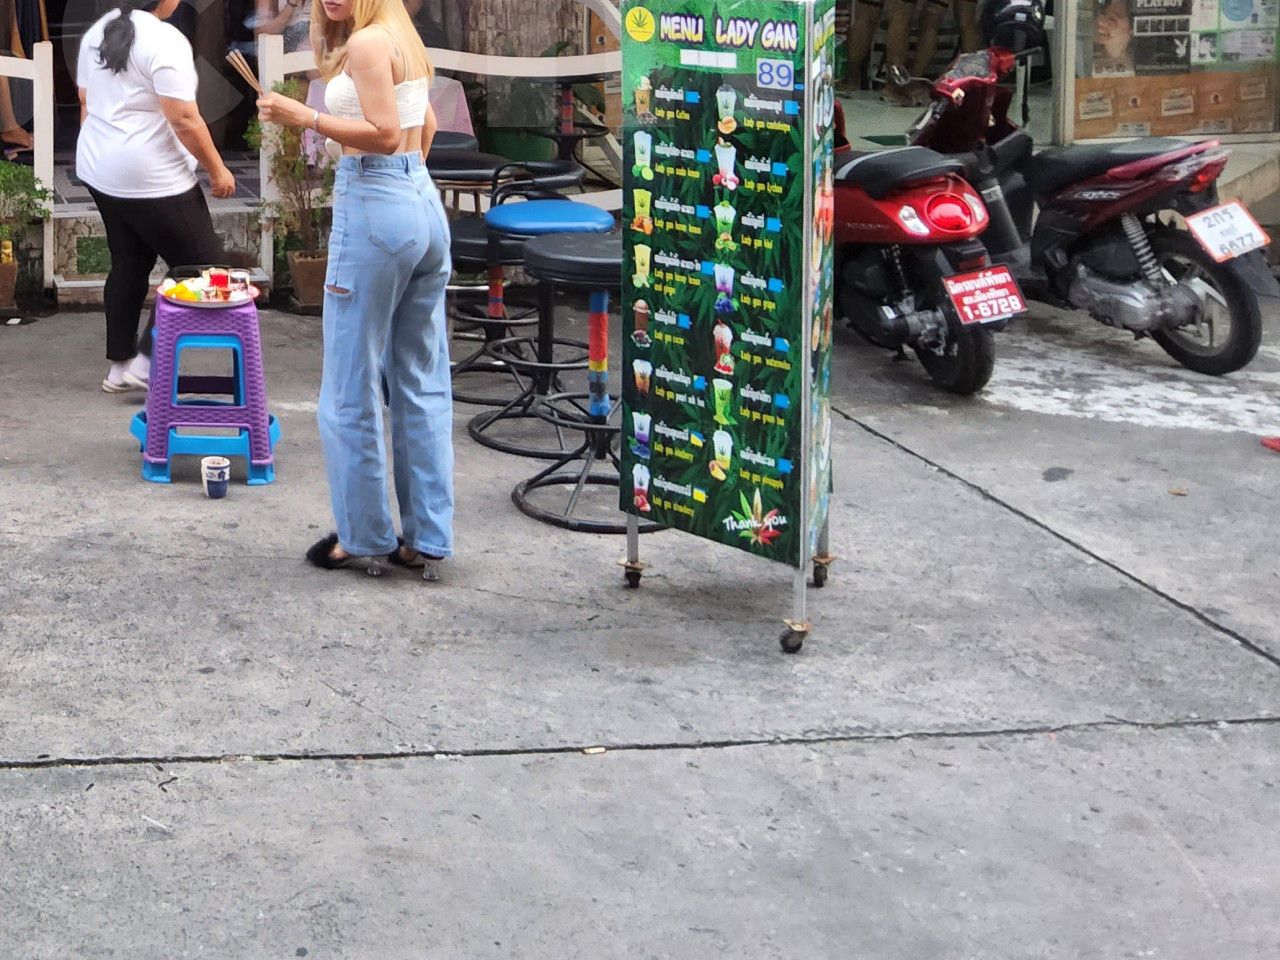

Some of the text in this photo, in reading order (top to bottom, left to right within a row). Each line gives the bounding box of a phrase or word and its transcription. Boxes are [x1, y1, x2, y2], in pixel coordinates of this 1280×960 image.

[660, 13, 799, 51] MENU LADY GAN
[758, 61, 793, 88] 89
[722, 515, 788, 531] Thank you
